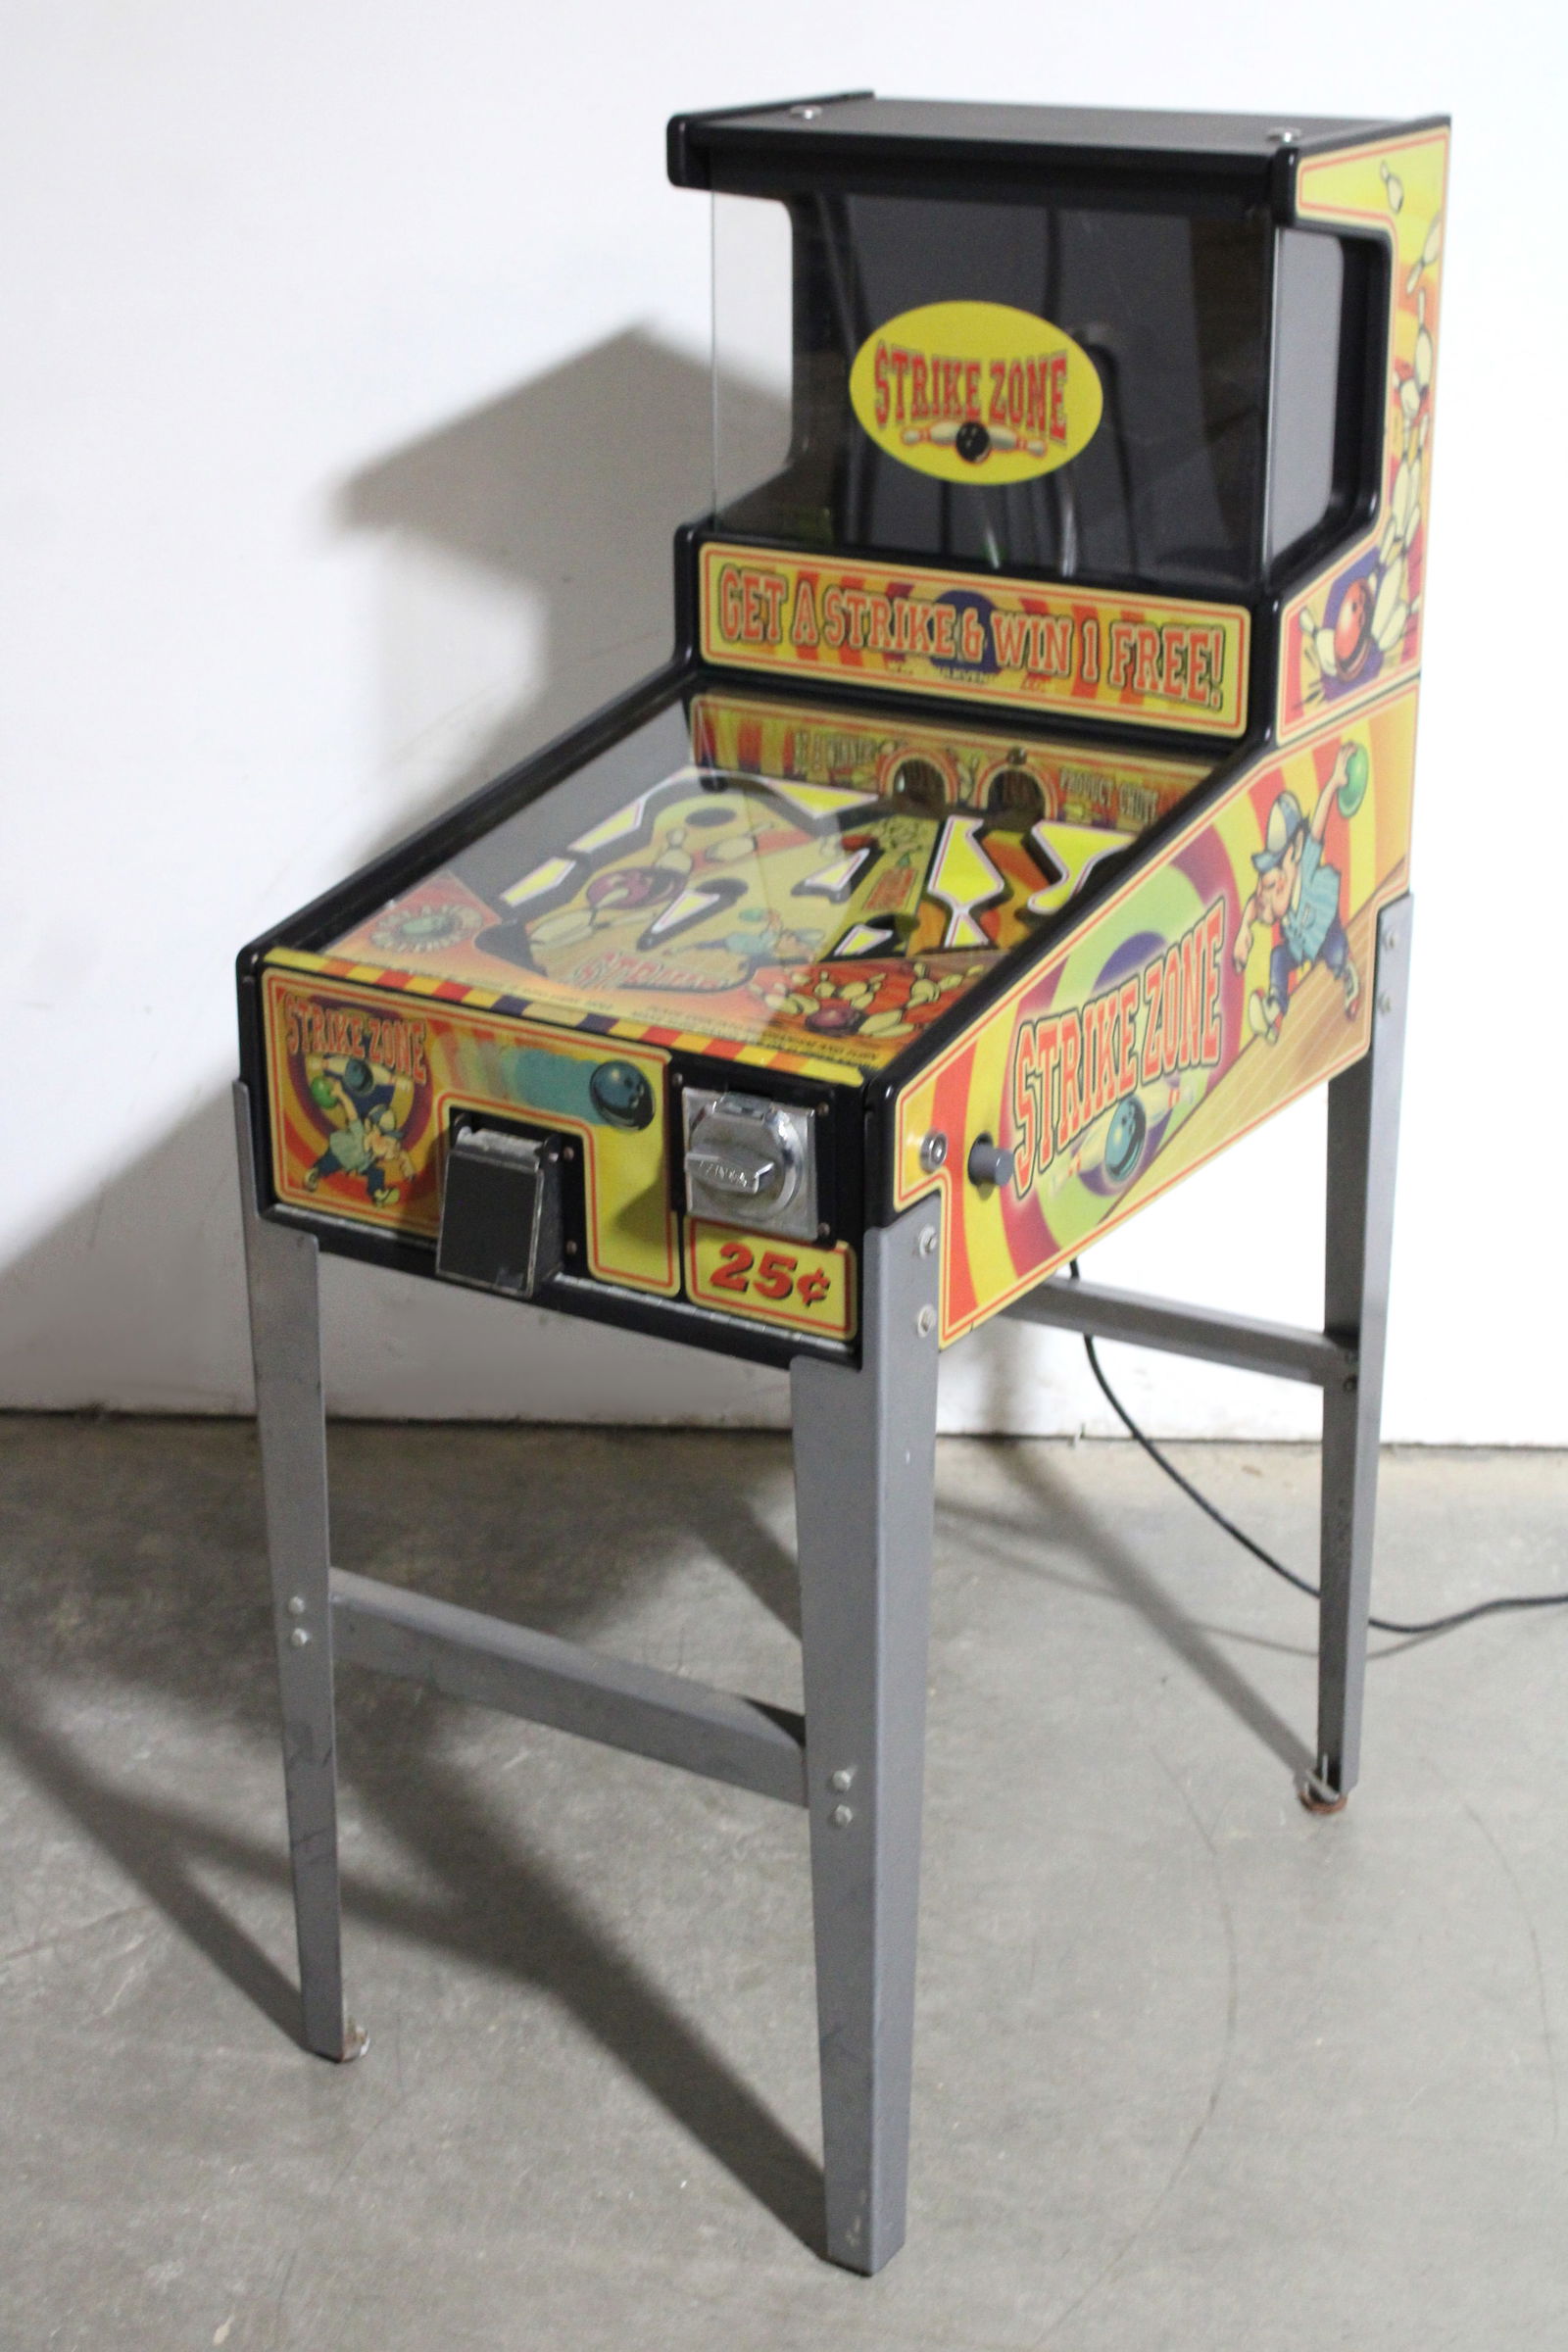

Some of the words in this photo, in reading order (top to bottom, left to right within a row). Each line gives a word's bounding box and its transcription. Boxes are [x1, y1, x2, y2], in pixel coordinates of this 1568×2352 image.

[872, 339, 982, 428] STRIKE
[989, 349, 1069, 447] ZONE
[719, 563, 788, 644] GET
[792, 576, 821, 648] A
[823, 587, 957, 659] STRIKE
[960, 605, 986, 662] &
[991, 610, 1076, 676] WIN
[1080, 619, 1102, 684] 1
[1107, 620, 1226, 710] FREE!
[284, 993, 366, 1059] STRIKE
[368, 1018, 427, 1086] ZONE
[1012, 976, 1141, 1200] STRIKE
[1141, 895, 1225, 1087] ZONE
[709, 1241, 832, 1308] 25¢
